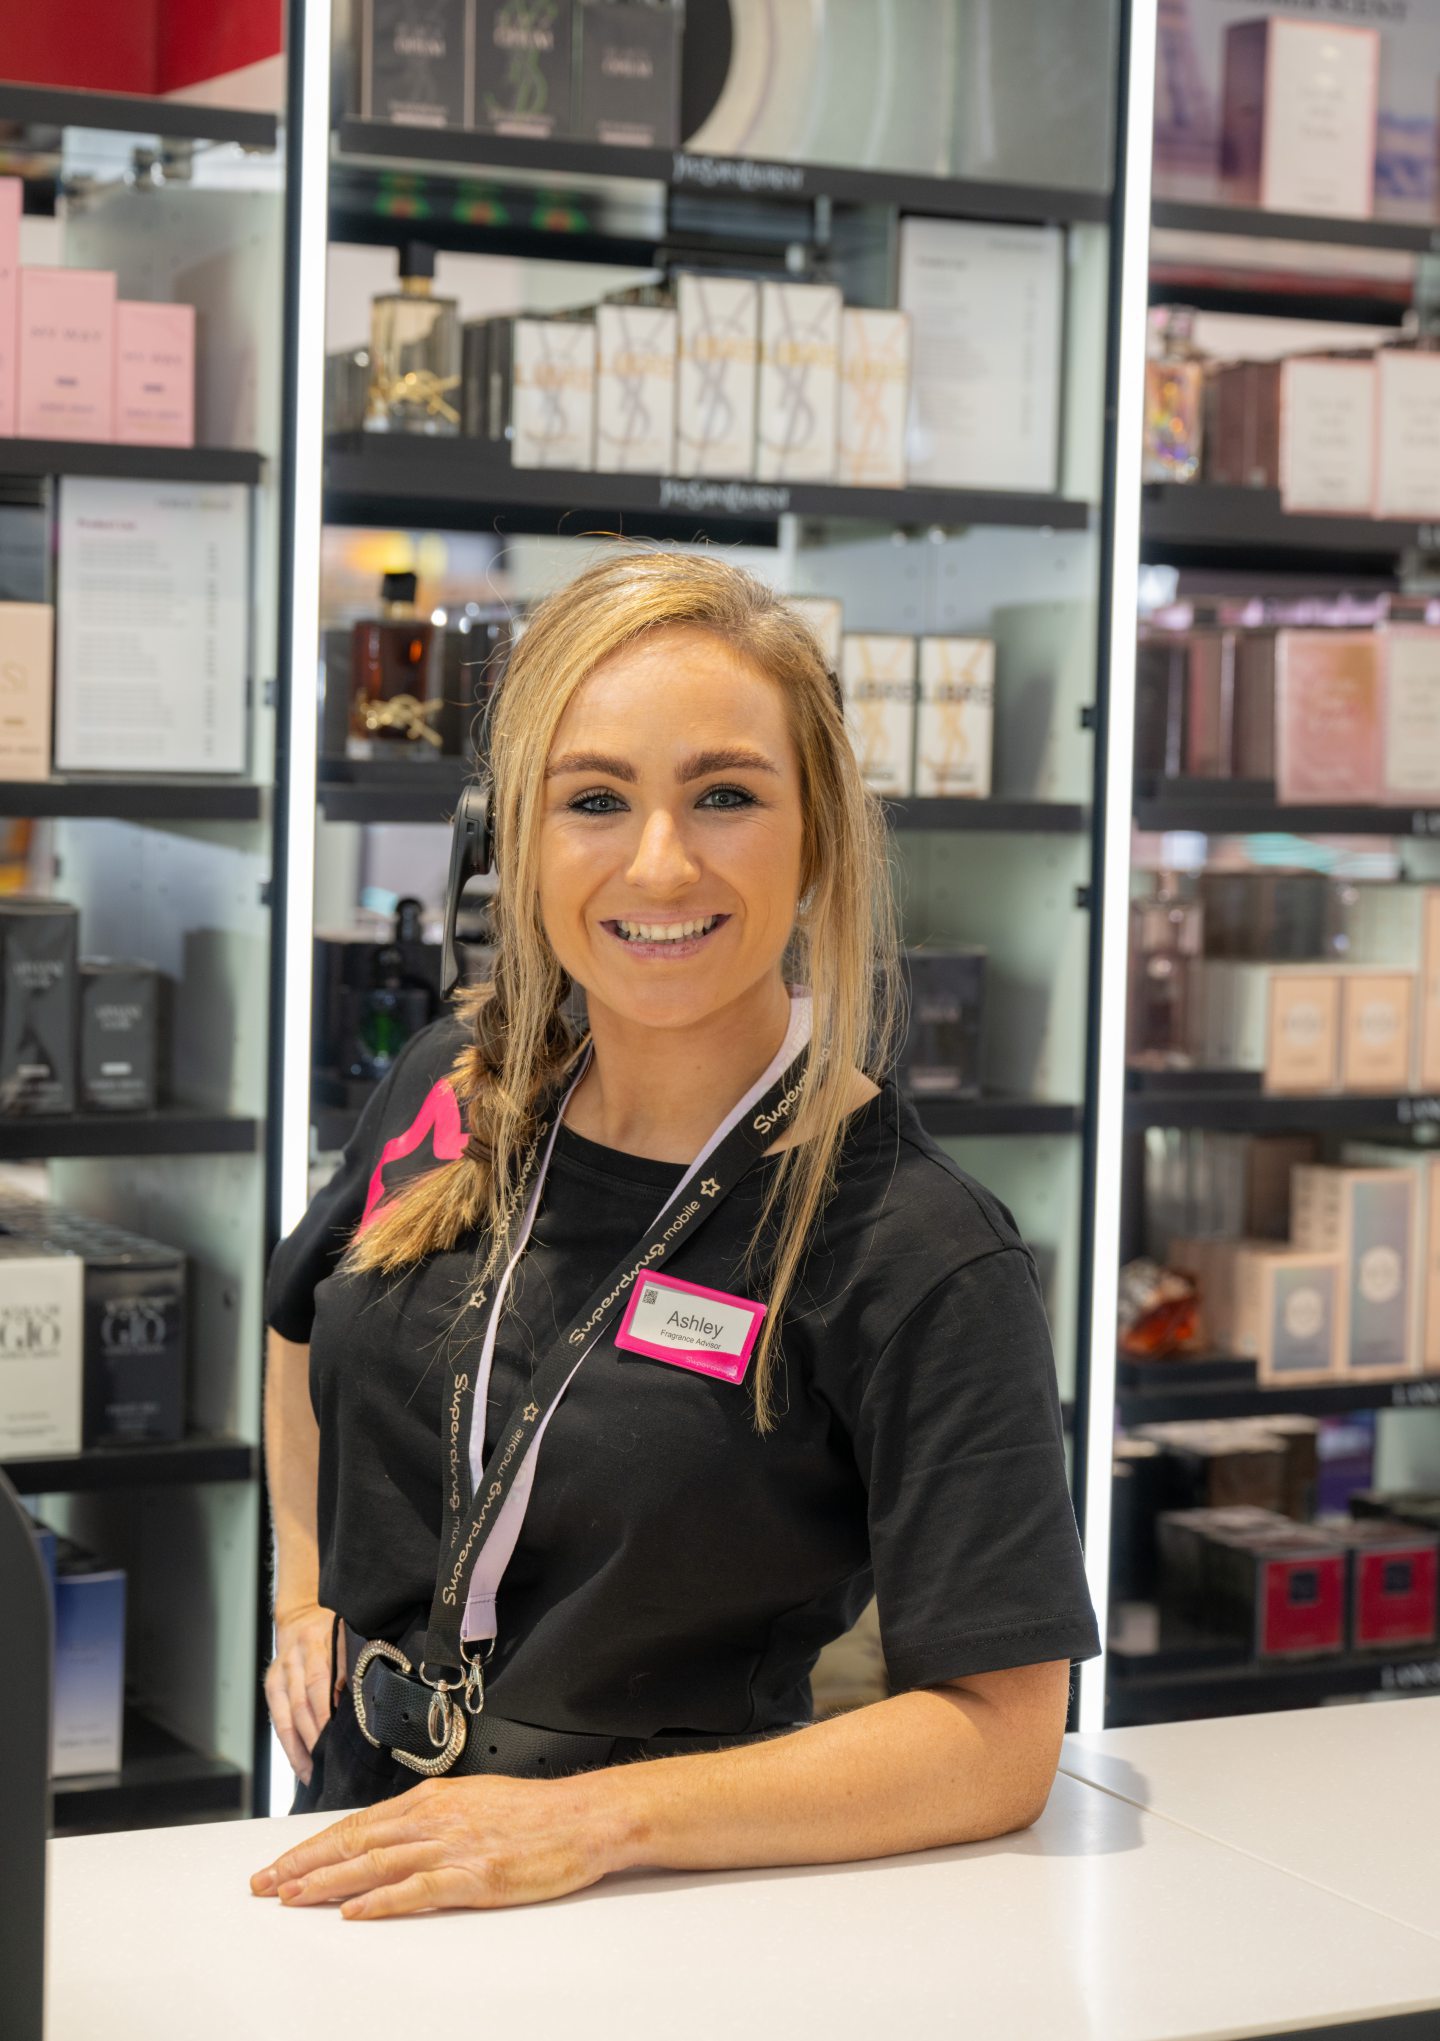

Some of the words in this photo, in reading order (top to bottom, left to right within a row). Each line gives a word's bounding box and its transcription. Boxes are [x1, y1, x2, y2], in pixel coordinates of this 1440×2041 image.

[569, 1243, 666, 1346] Superdrug
[663, 1200, 700, 1242] mobile
[660, 1329, 695, 1344] Fragrance
[695, 1337, 721, 1350] Advisor
[667, 1311, 724, 1339] Ashley
[450, 1373, 468, 1511] Superdrug
[443, 1480, 502, 1606] Superdrug
[497, 1428, 524, 1477] mobile
